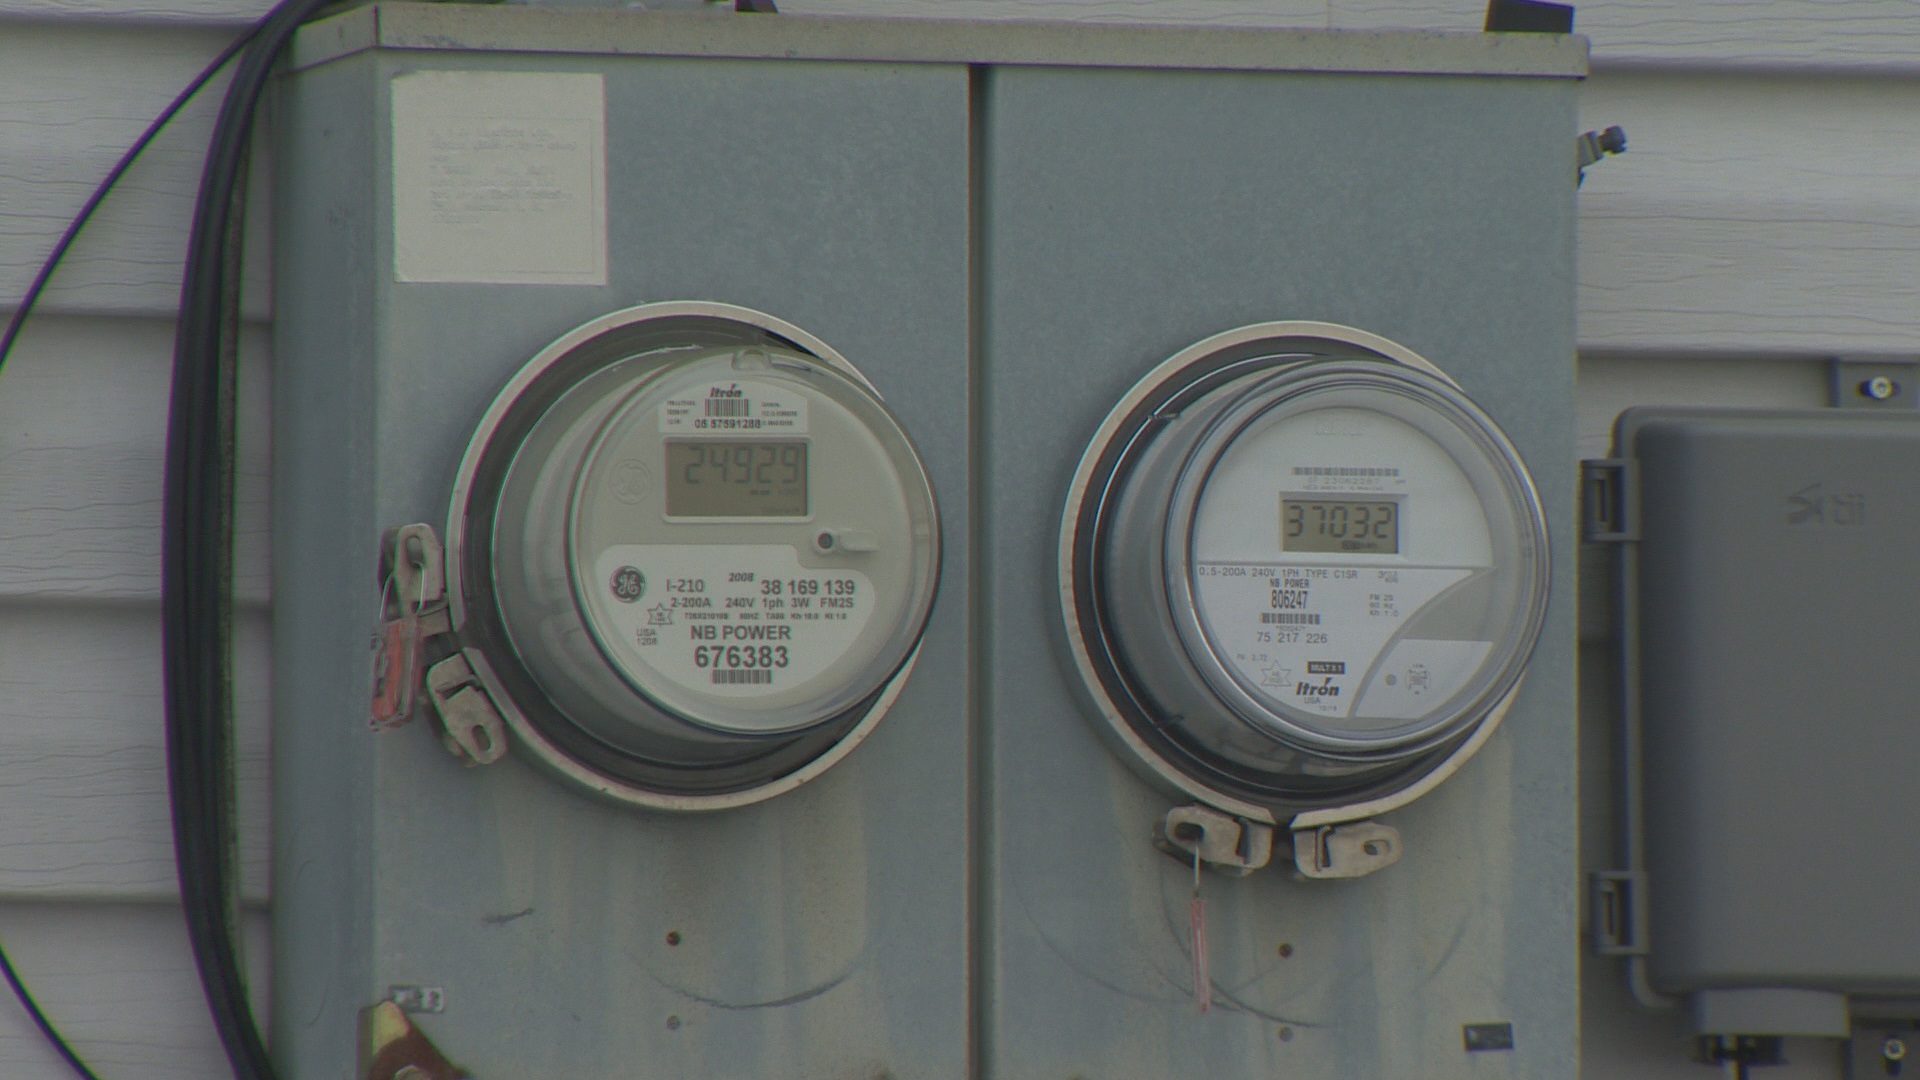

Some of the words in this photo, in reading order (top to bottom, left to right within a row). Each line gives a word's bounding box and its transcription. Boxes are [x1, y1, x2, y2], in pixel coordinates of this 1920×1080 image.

[684, 446, 800, 484] 24929
[1287, 505, 1393, 540] 37032
[1199, 566, 1246, 577] 0.5-200A
[1252, 567, 1275, 578] 240V
[1305, 569, 1329, 580] TYPE
[666, 579, 704, 593] I-210
[761, 579, 782, 596] 38
[788, 579, 818, 596] 169
[824, 580, 855, 596] 139
[1284, 578, 1310, 589] POWER
[670, 597, 711, 609] 2-200A
[725, 597, 755, 609] 240V
[761, 598, 784, 611] 1ph
[791, 597, 810, 609] 3W
[819, 597, 854, 609] FM2S
[1271, 589, 1309, 610] 806247
[690, 625, 718, 640] NB
[722, 625, 792, 640] POWER
[1256, 632, 1271, 643] 75
[1277, 633, 1298, 644] 217
[1306, 633, 1328, 644] 226
[693, 645, 790, 668] 676383
